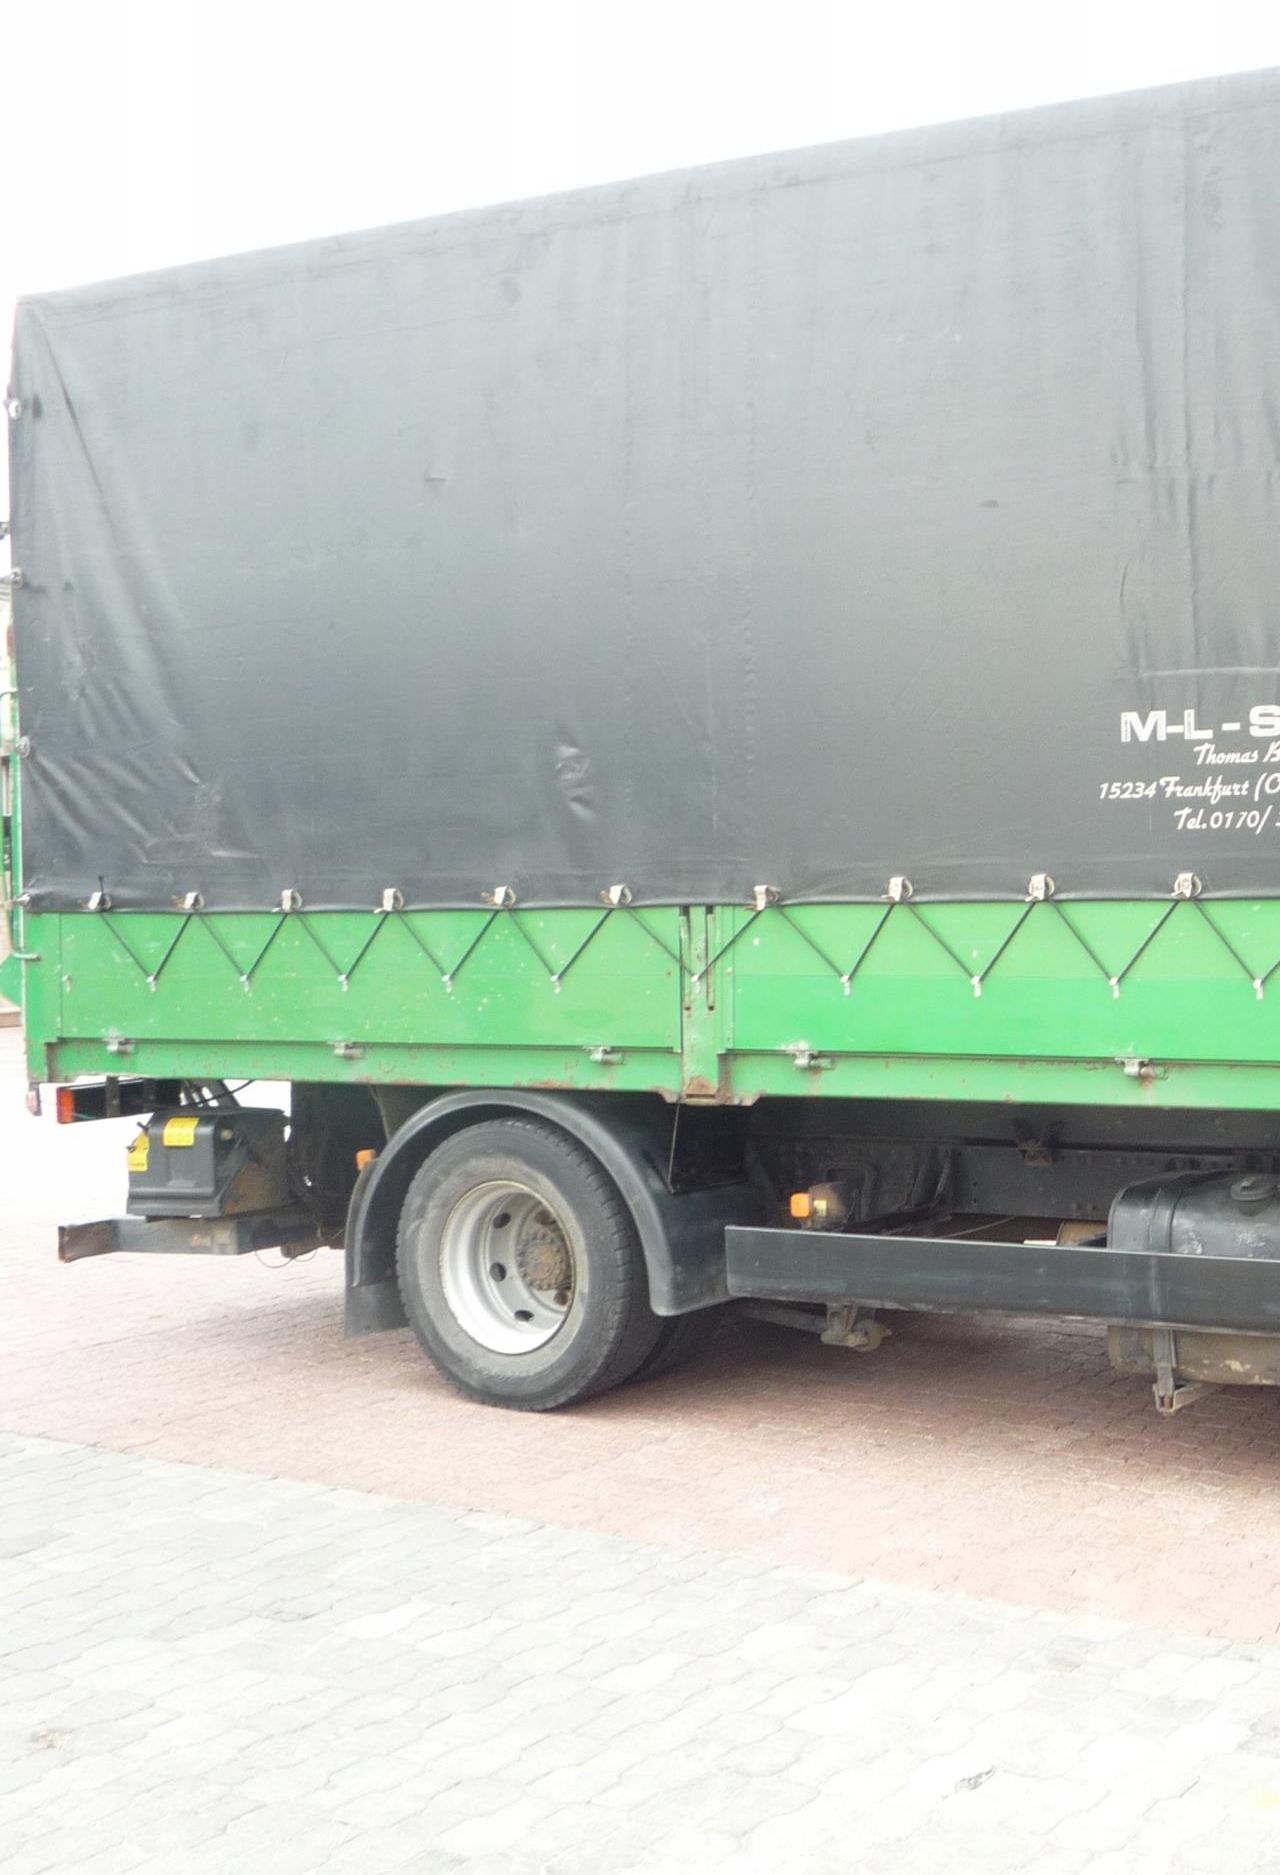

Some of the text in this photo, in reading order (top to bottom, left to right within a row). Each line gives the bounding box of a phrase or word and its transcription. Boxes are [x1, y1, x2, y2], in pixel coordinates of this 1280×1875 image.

[1120, 709, 1214, 743] M-L
[1193, 743, 1259, 766] Thomas
[1100, 781, 1158, 799] 15234
[1159, 775, 1250, 805] Frankfurt
